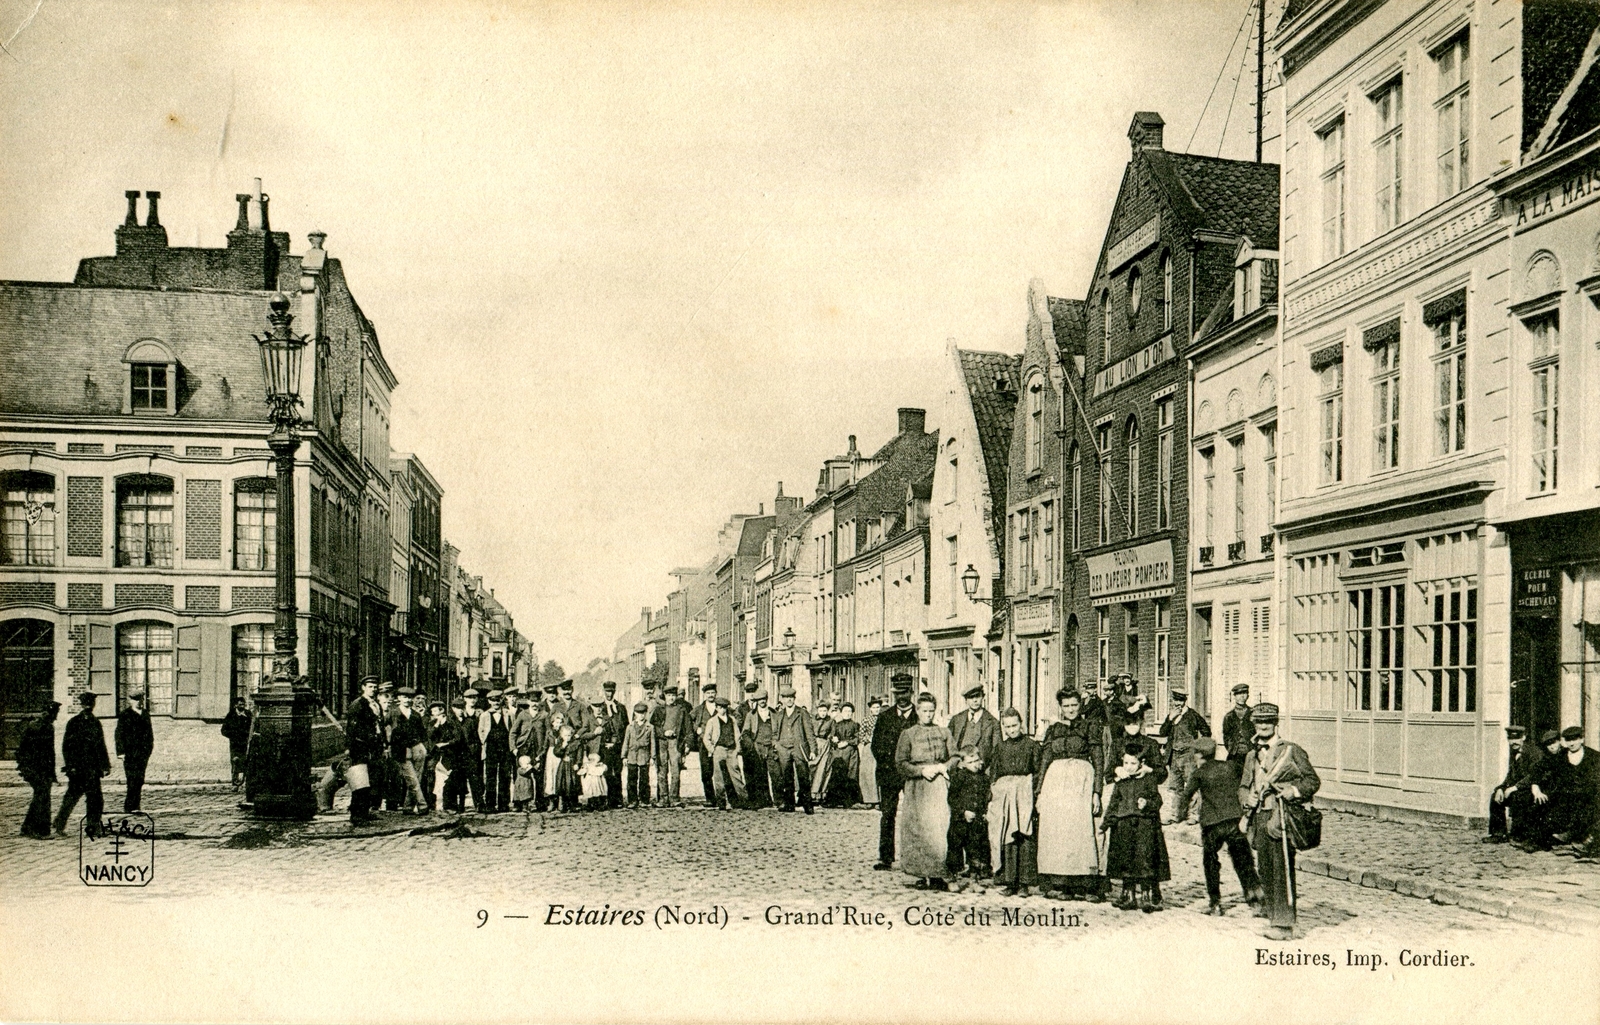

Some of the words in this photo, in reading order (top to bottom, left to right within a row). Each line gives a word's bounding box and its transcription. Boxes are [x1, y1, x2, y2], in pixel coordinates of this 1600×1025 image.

[1517, 203, 1528, 227] A
[1532, 192, 1554, 219] LA
[1104, 367, 1114, 390] AU
[1120, 355, 1137, 382] LION
[1105, 567, 1132, 591] SAPEURS
[1134, 560, 1169, 586] POMPIERS
[1527, 582, 1547, 593] POUR
